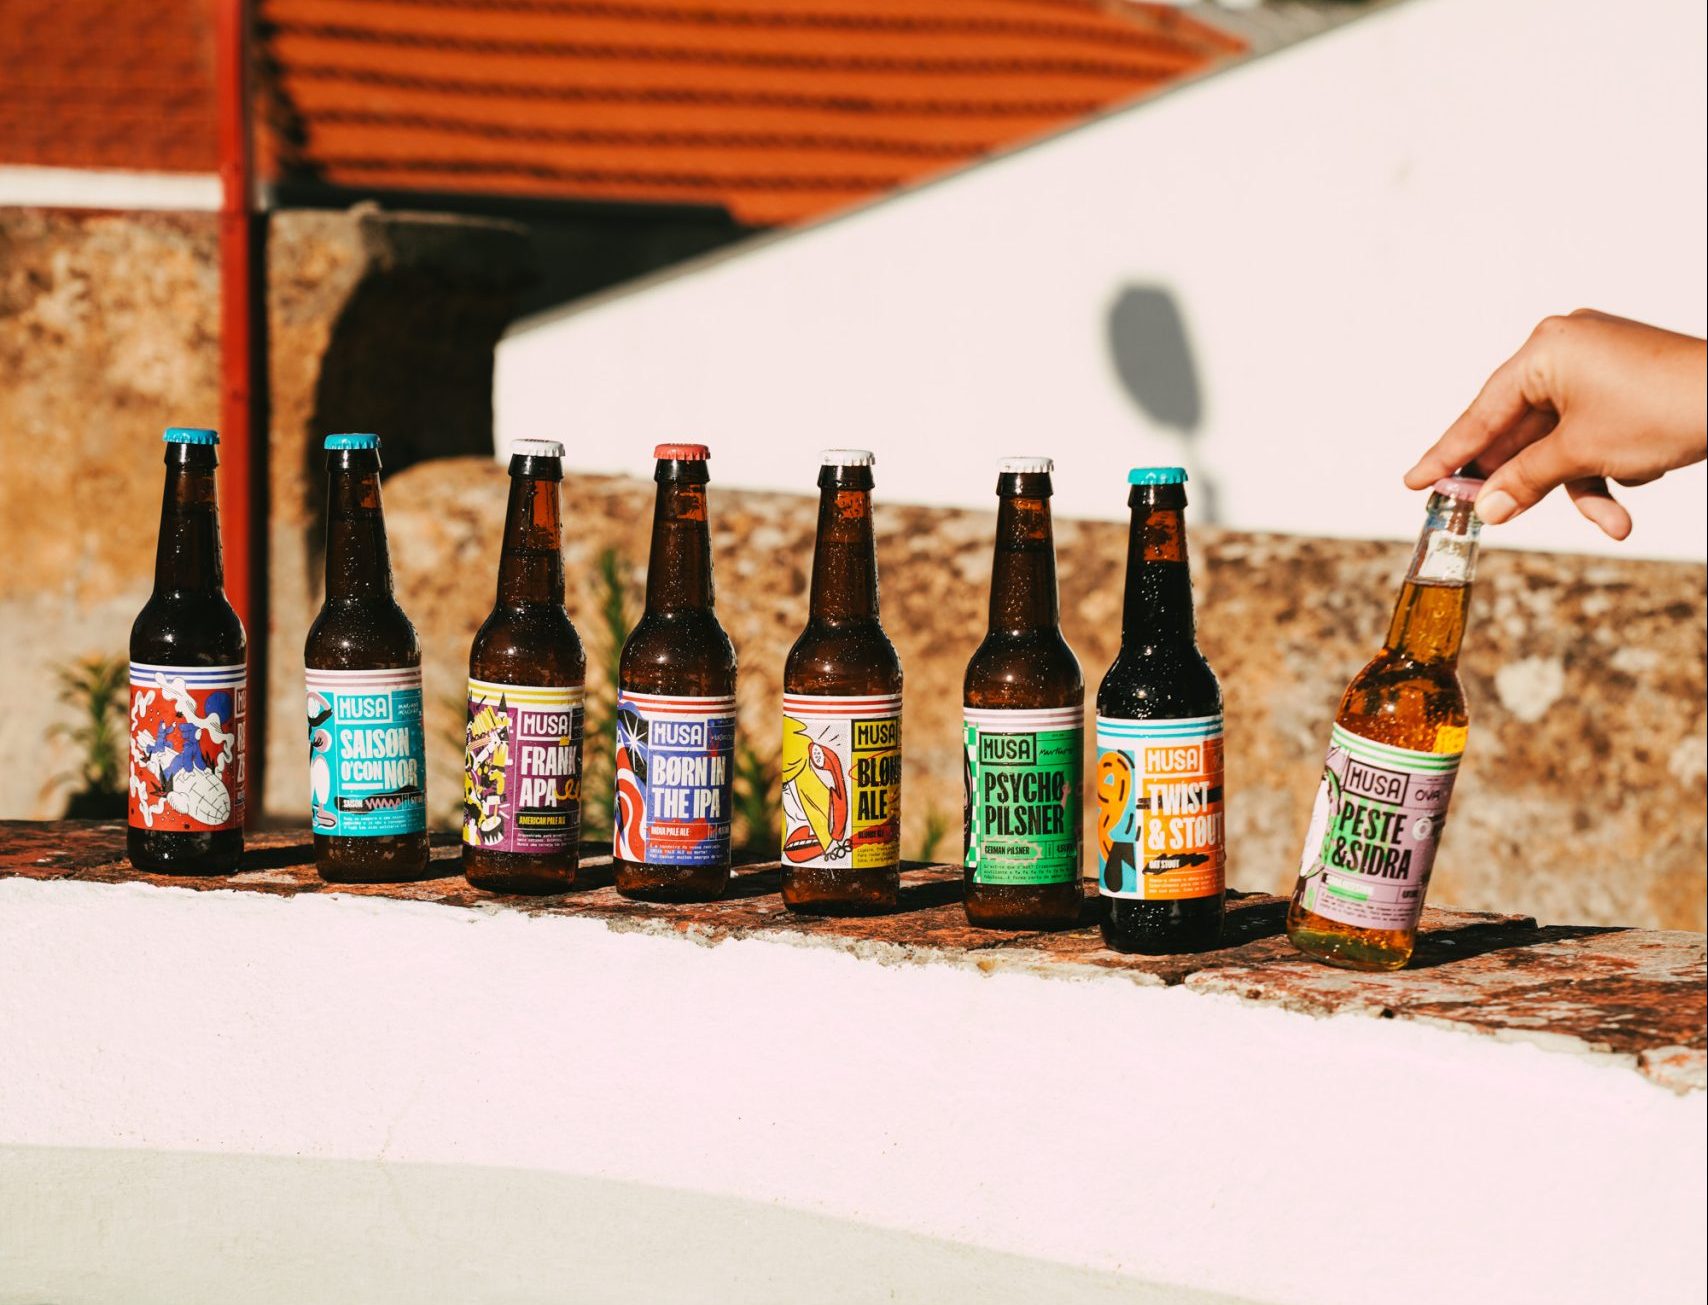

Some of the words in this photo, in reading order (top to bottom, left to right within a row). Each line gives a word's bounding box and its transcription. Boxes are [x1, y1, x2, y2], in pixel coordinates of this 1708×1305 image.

[339, 697, 387, 718] MUSA
[523, 714, 568, 735] MUSA
[654, 723, 703, 745] MUSA
[858, 724, 895, 745] MUSA
[340, 728, 409, 759] SAISØN
[984, 739, 1030, 760] MUSA
[341, 761, 382, 781] O'CON
[384, 758, 418, 790] NOR
[521, 746, 577, 776] FRANK
[653, 755, 708, 787] BØRN
[711, 756, 726, 786] IN
[1146, 749, 1198, 772] MUSA
[519, 778, 557, 807] APA
[984, 771, 1064, 803] PSYCHØ
[1349, 767, 1401, 799] MUSA
[652, 788, 690, 818] THE
[694, 788, 720, 818] IPA
[858, 790, 887, 820] ALE
[1147, 781, 1210, 816] TWIST
[667, 827, 679, 836] PALE
[680, 828, 689, 836] ALE
[985, 804, 1064, 836] PILSNER
[1148, 818, 1166, 850] &
[1338, 800, 1408, 845] PESTE
[985, 846, 1005, 855] GERMAN
[1007, 847, 1030, 855] PILSNER
[1331, 836, 1412, 880] &SIDRA
